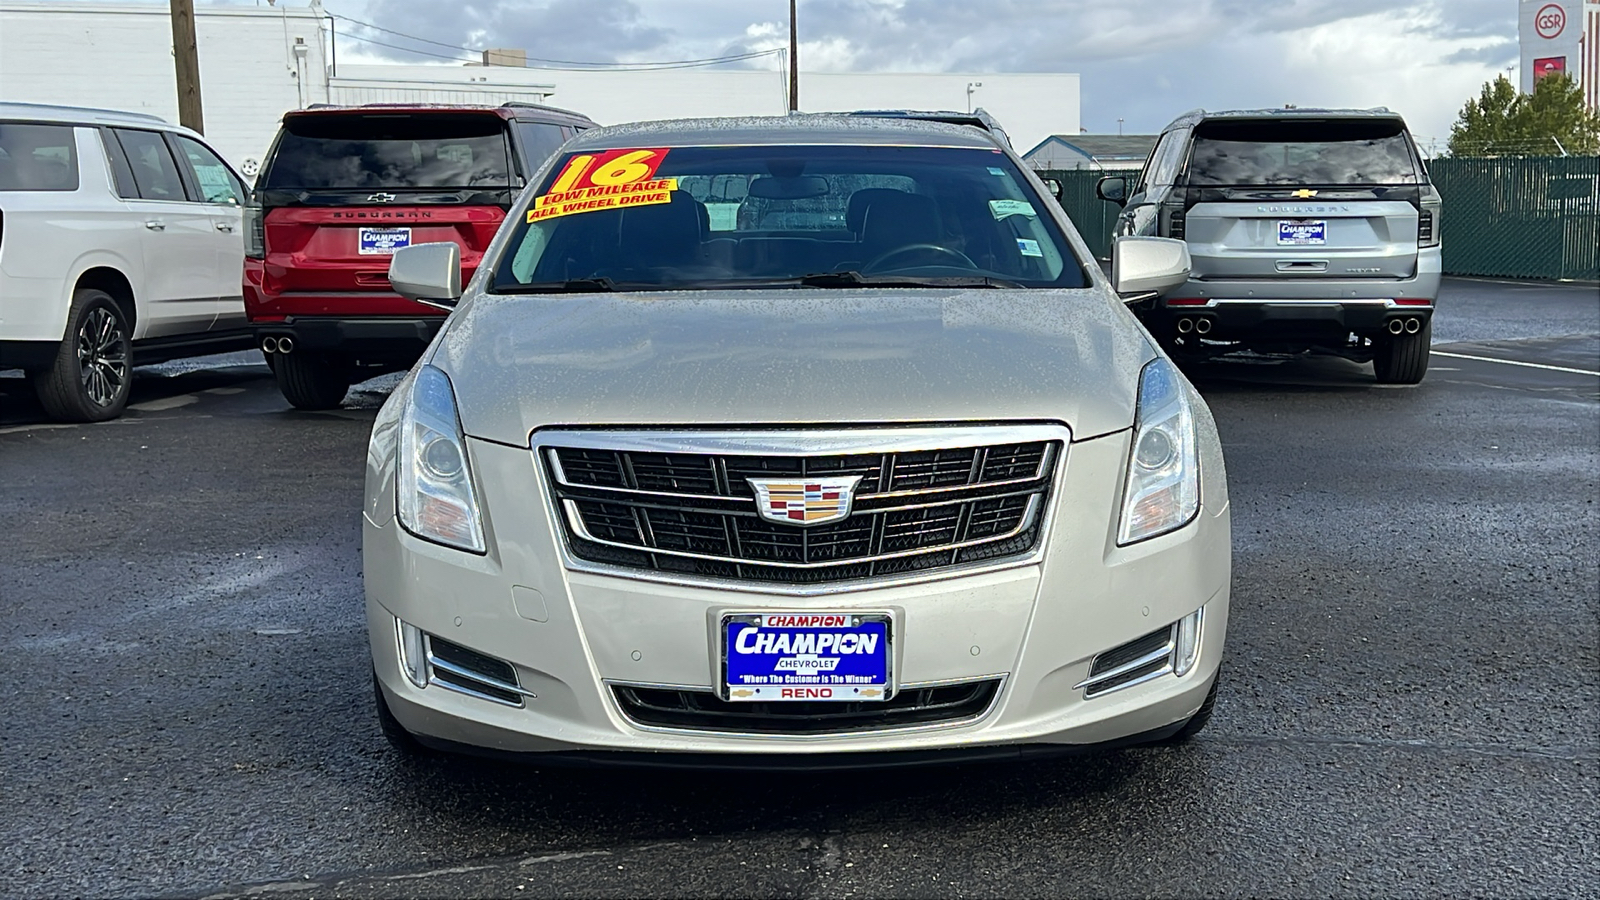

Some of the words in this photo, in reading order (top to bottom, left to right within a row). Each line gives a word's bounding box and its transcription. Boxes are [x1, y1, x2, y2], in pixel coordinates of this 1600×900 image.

[1539, 14, 1561, 29] GSR
[551, 150, 657, 193] 16
[542, 191, 585, 206] LOW
[586, 180, 671, 198] MILEAGE
[529, 208, 559, 220] ALL
[562, 199, 616, 213] WHEEL
[619, 192, 668, 204] DRIVE
[1281, 225, 1323, 233] CHAMPION
[363, 232, 408, 242] CHAMPION
[767, 616, 846, 627] CHAMPION
[735, 628, 878, 654] CHAMPION
[779, 660, 835, 668] CHEVROLET
[739, 675, 768, 683] "Where
[769, 675, 784, 683] The
[785, 675, 820, 683] Customer
[821, 675, 829, 683] Is
[830, 675, 844, 683] The
[845, 675, 877, 683] Winner"
[781, 688, 833, 698] RENO
